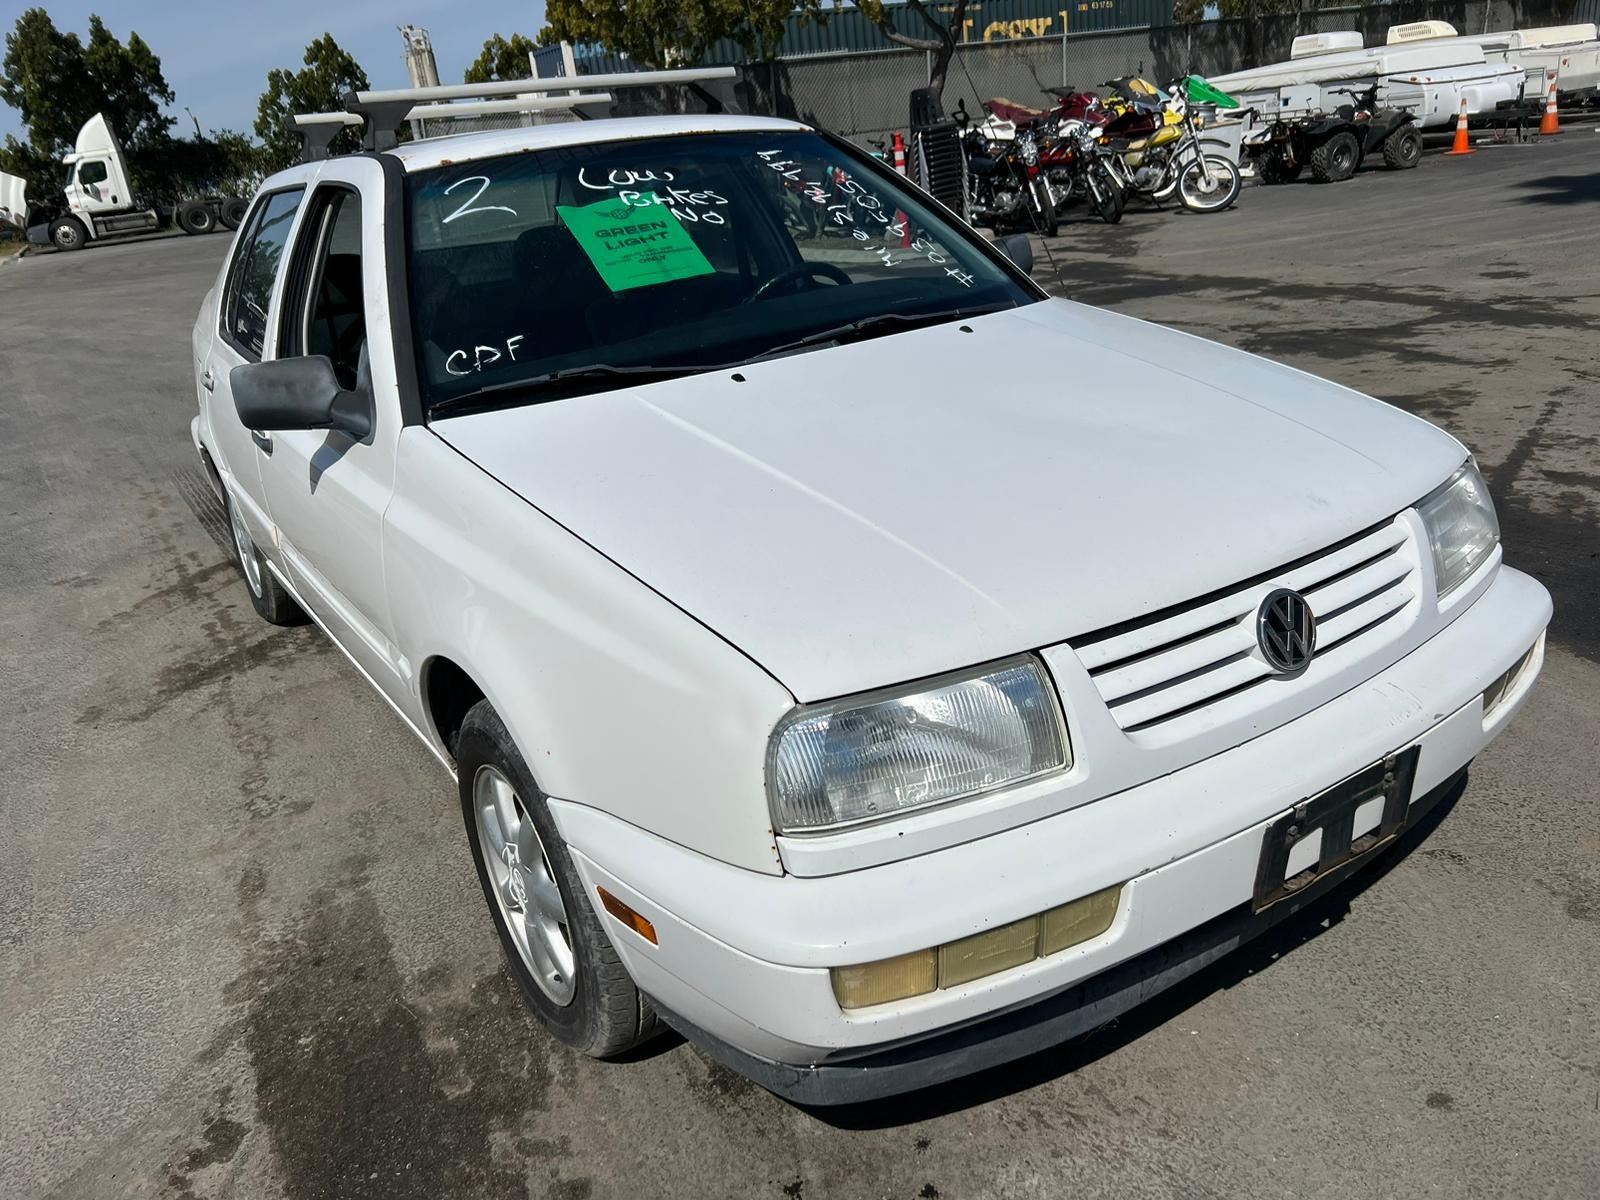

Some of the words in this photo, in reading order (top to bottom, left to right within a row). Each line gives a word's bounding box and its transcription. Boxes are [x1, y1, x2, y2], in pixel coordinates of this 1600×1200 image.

[441, 175, 518, 224] 2
[594, 220, 669, 239] GREEN
[604, 231, 669, 251] LIGHT
